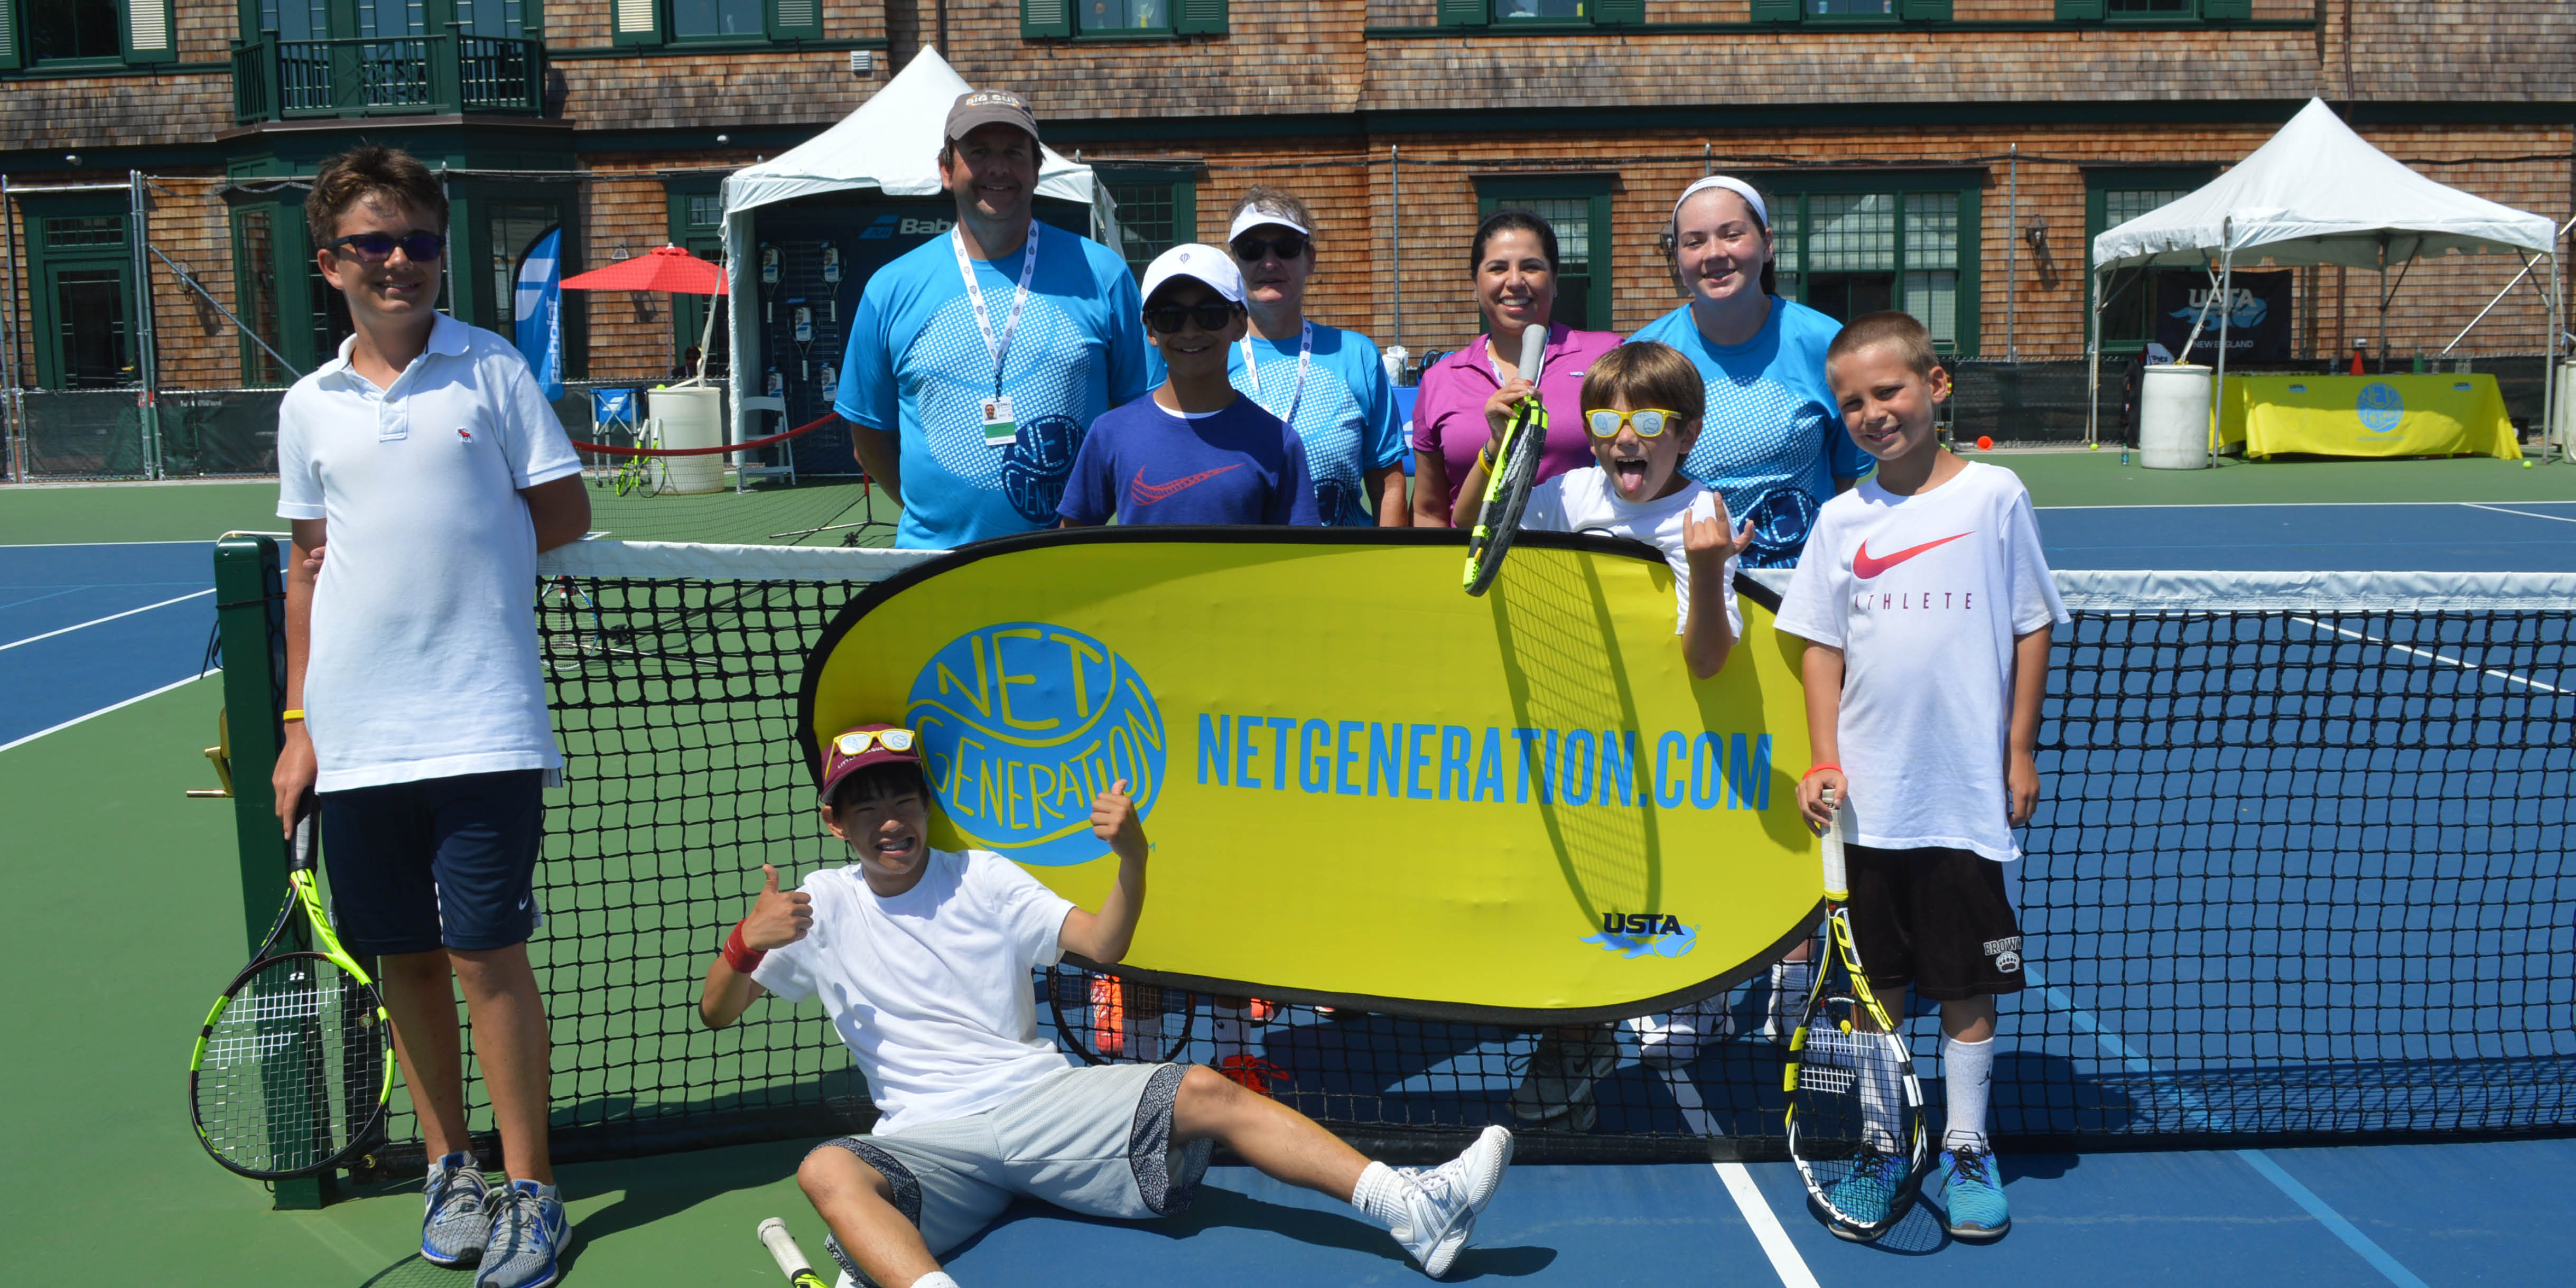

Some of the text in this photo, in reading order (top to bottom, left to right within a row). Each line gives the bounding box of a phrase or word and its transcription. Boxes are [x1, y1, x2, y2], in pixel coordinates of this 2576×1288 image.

[900, 218, 956, 234] Bab
[1013, 416, 1075, 468] NET
[1005, 469, 1064, 516] GENER
[936, 628, 1104, 730] NET
[916, 678, 1161, 830] GENERATION
[1197, 713, 1772, 810] NETGENERATION.COM
[1602, 912, 1686, 936] USTA
